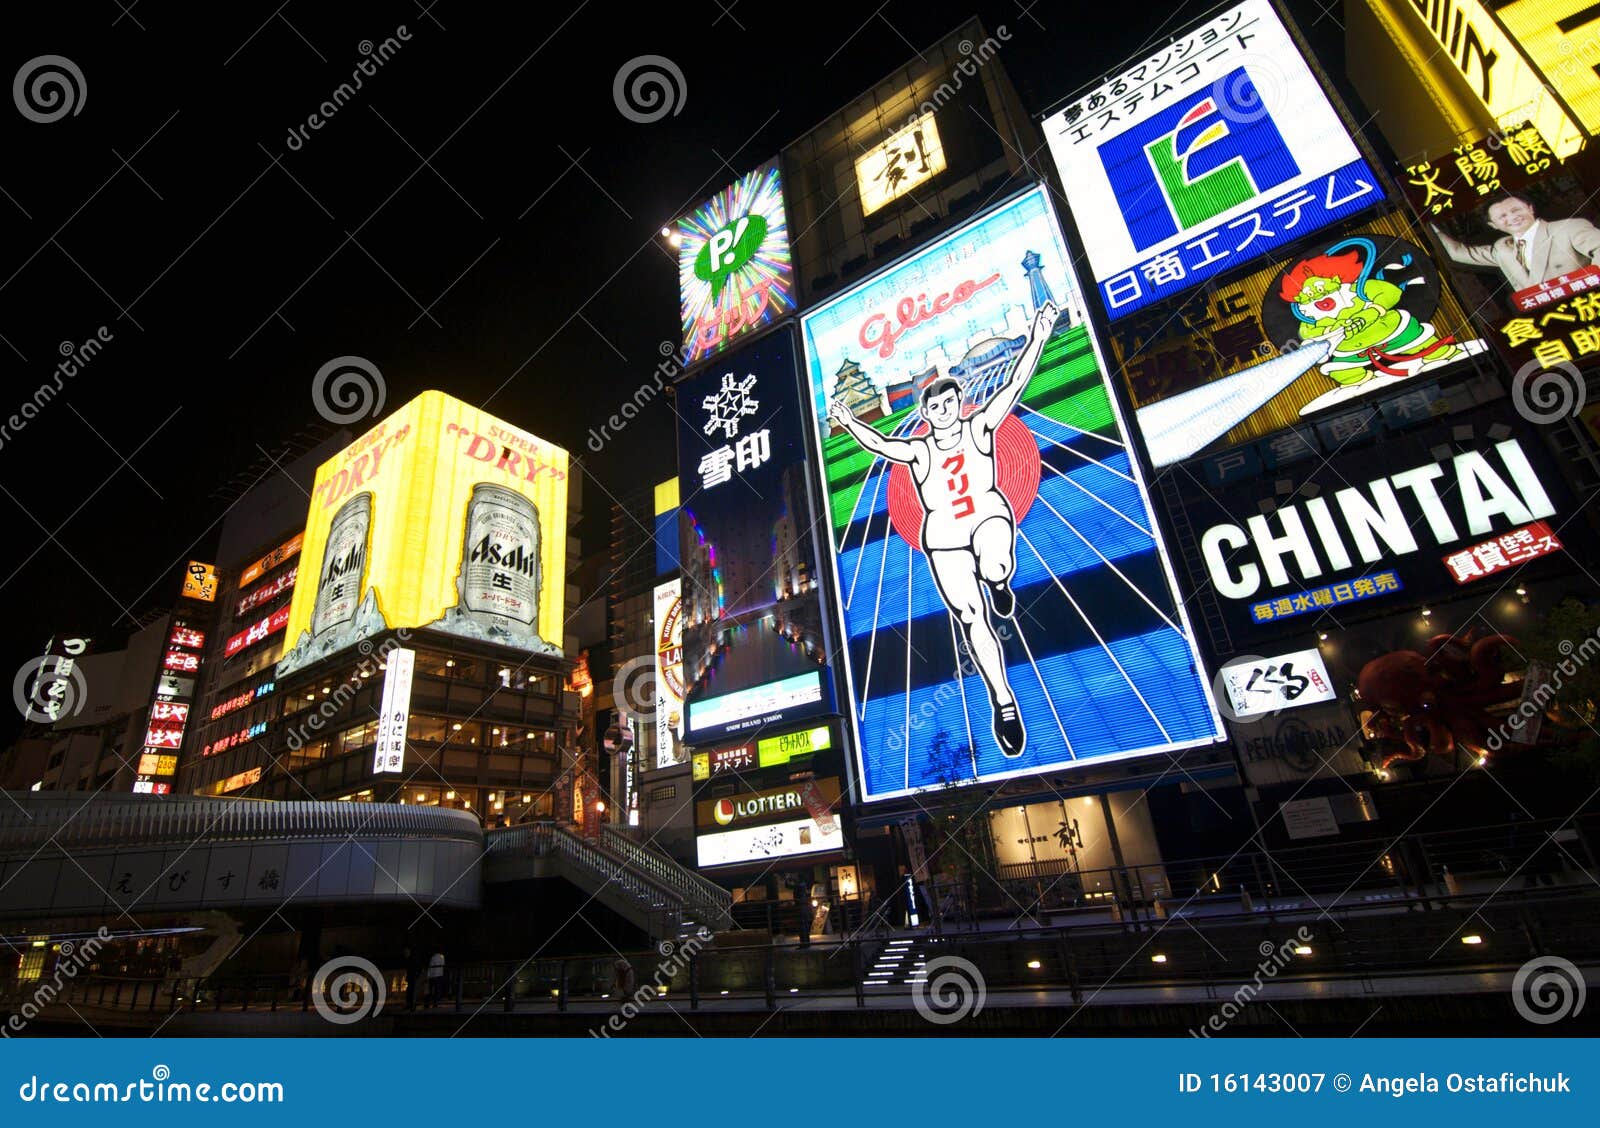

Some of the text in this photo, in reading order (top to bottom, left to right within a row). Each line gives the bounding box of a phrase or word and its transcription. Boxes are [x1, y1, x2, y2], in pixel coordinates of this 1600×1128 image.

[1063, 11, 1242, 125] 夢あるマンション
[1071, 34, 1255, 144] エステムコート
[1104, 175, 1374, 309] 日商エステム
[489, 424, 539, 456] SUPER
[697, 428, 771, 490] 雪印
[941, 448, 976, 520] グリコ
[1201, 438, 1556, 600] CHINTAI
[321, 543, 364, 591] Asahi
[471, 533, 534, 578] Asahi
[1447, 544, 1509, 583] 賃貸
[331, 583, 345, 602] 生
[492, 572, 513, 592] 生
[657, 588, 677, 601] KIRIN
[1253, 573, 1400, 622] 毎週水曜日発売
[664, 617, 674, 639] KIRIN
[666, 647, 683, 666] LA
[1246, 662, 1309, 700] くくる
[153, 704, 188, 722] はや
[726, 714, 783, 732] SNOW BRAND VISION
[147, 728, 184, 746] はや
[738, 792, 802, 816] LOTTERI
[117, 868, 281, 895] えびす橋
